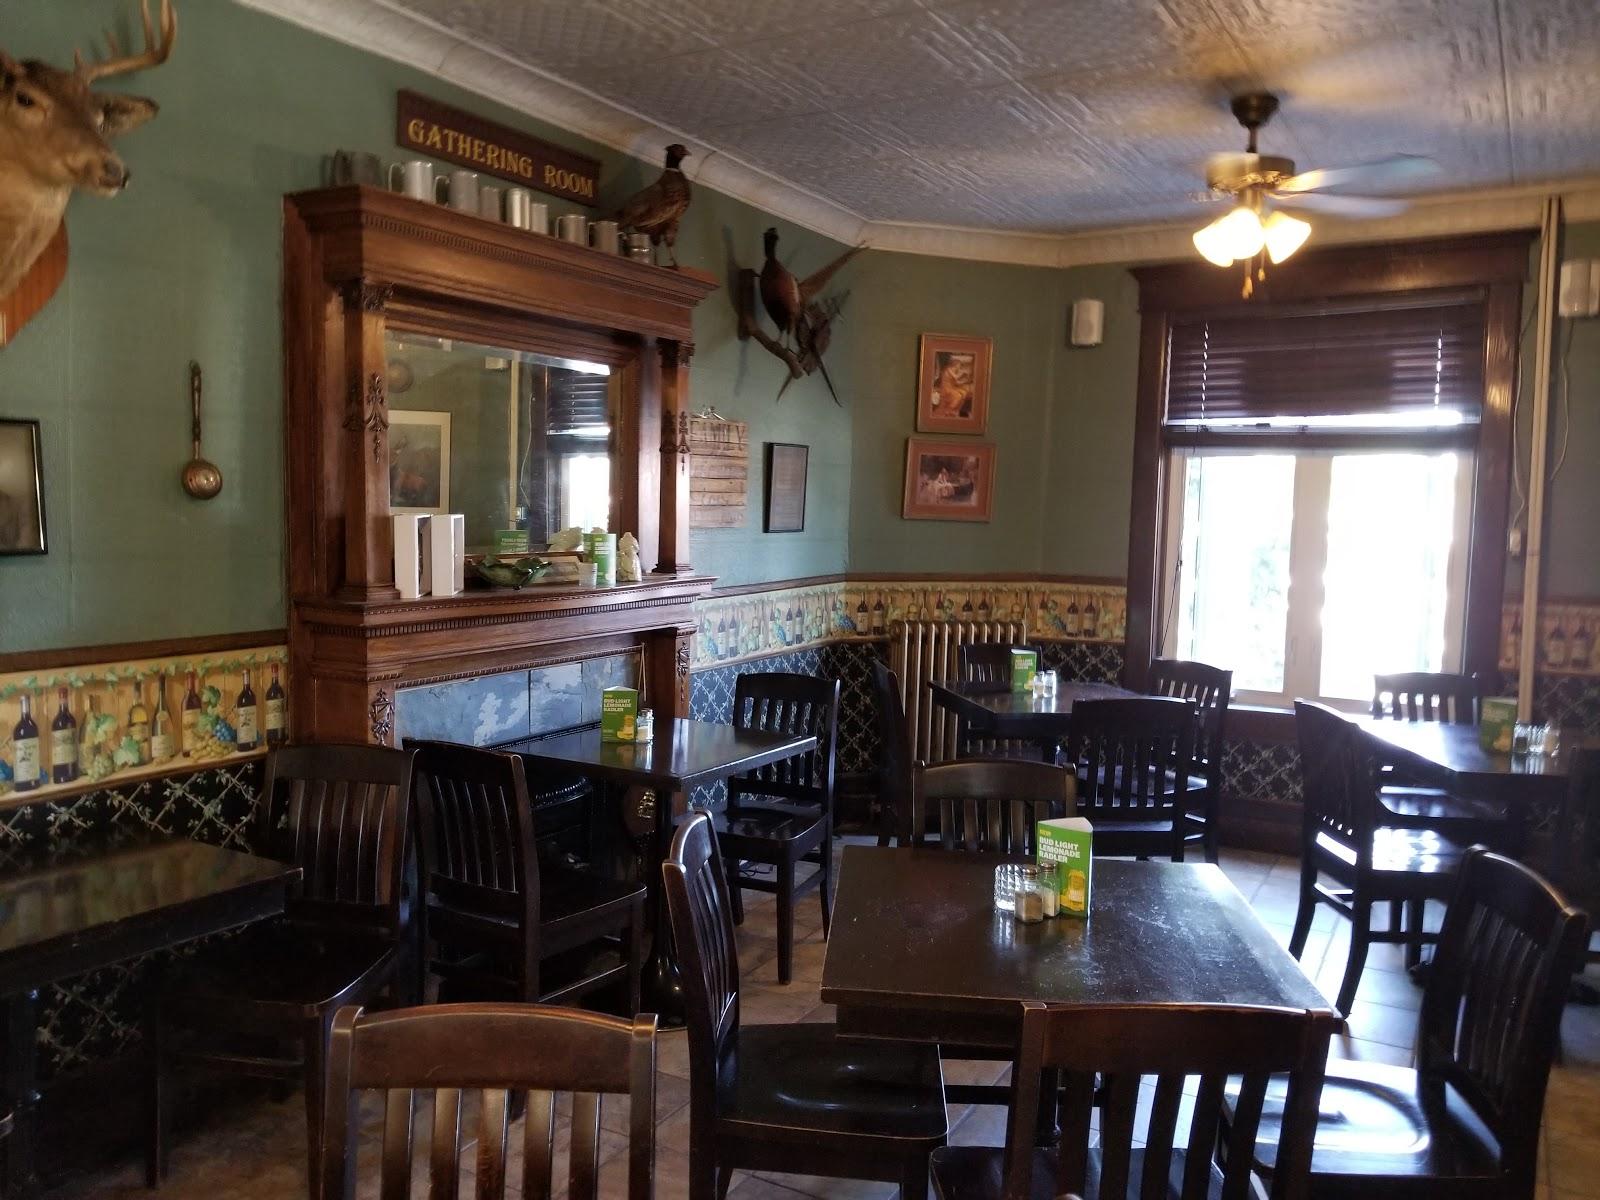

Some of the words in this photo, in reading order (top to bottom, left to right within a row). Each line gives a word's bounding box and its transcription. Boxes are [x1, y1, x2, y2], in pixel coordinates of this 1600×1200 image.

[407, 118, 533, 178] GATHERING
[544, 164, 594, 198] ROOM
[1039, 836, 1054, 846] BUD
[1055, 839, 1079, 850] LIGHT
[1038, 850, 1068, 864] RADLER
[1039, 843, 1081, 859] LEMONADE
